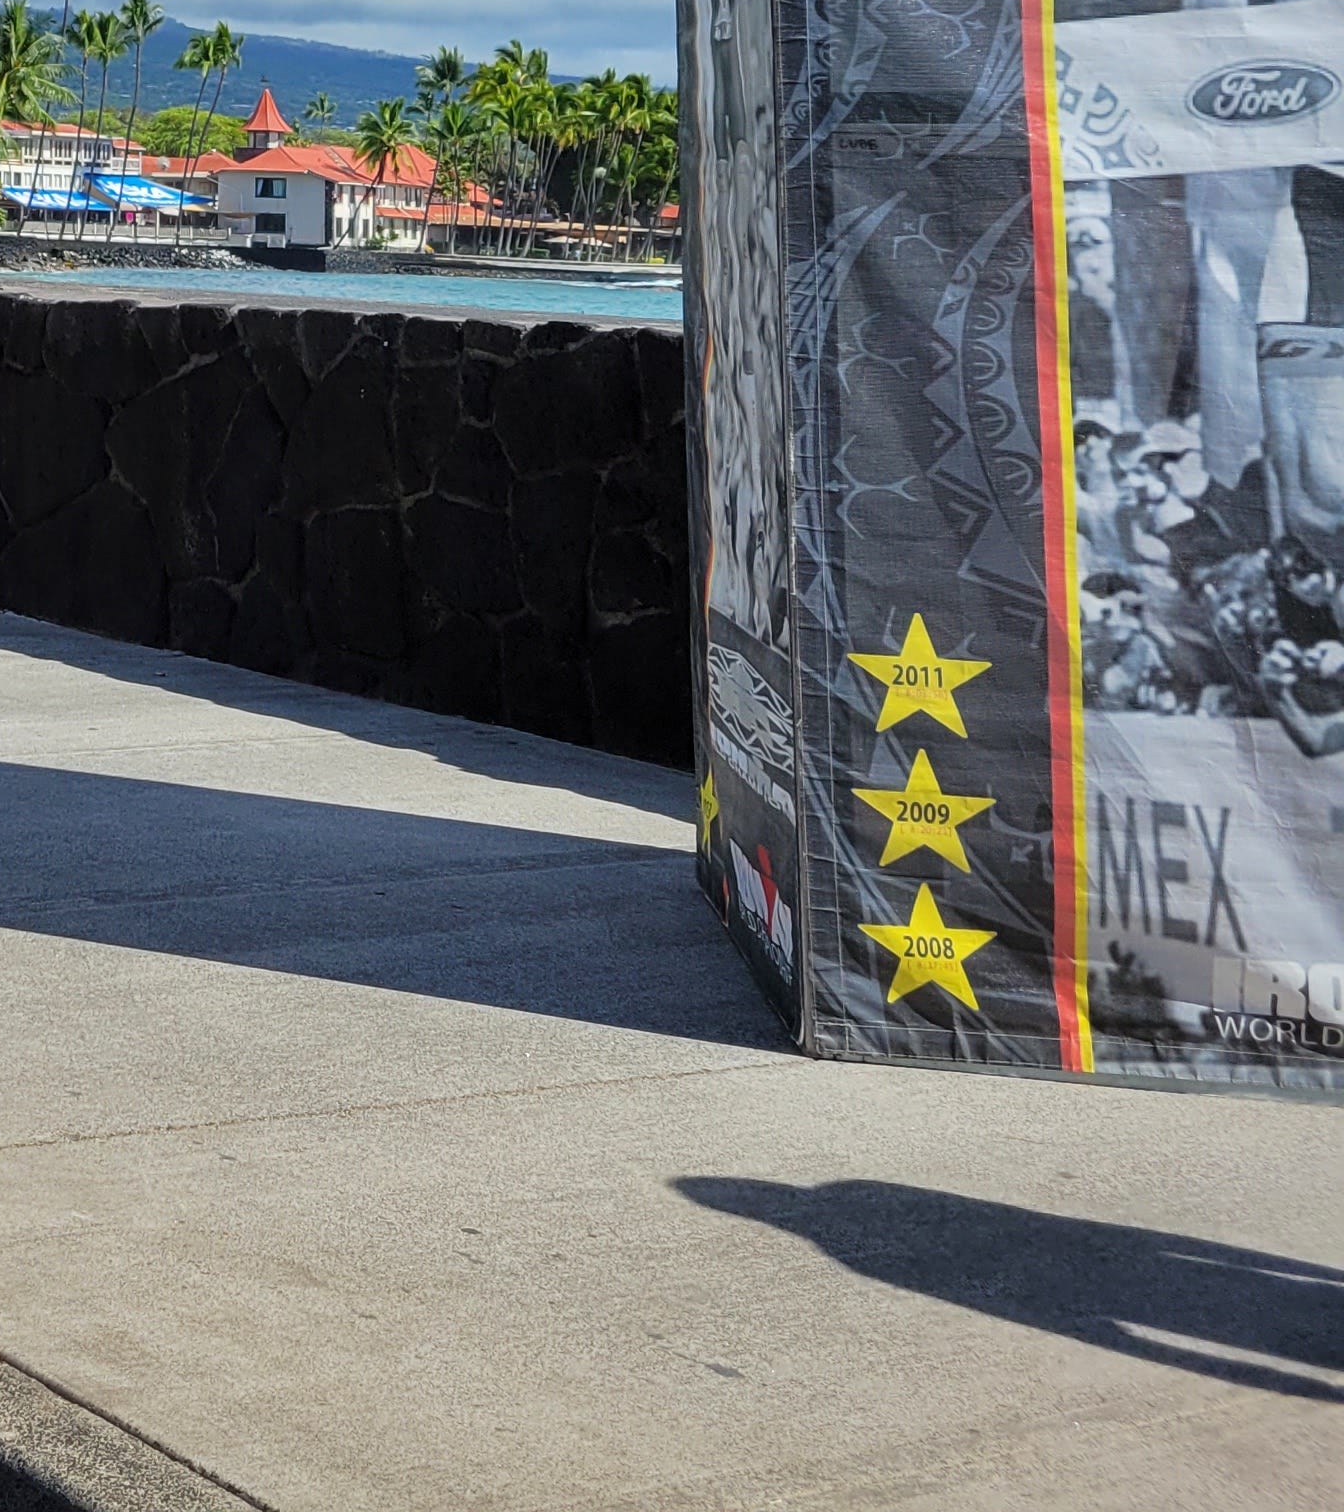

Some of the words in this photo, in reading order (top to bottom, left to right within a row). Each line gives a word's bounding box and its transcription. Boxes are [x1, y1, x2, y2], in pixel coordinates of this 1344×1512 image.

[1213, 70, 1309, 118] Ford
[892, 664, 943, 688] 2011
[896, 800, 950, 824] 2009
[1096, 791, 1249, 953] MEX
[903, 935, 955, 959] 2008
[1214, 1014, 1344, 1048] WORLD
